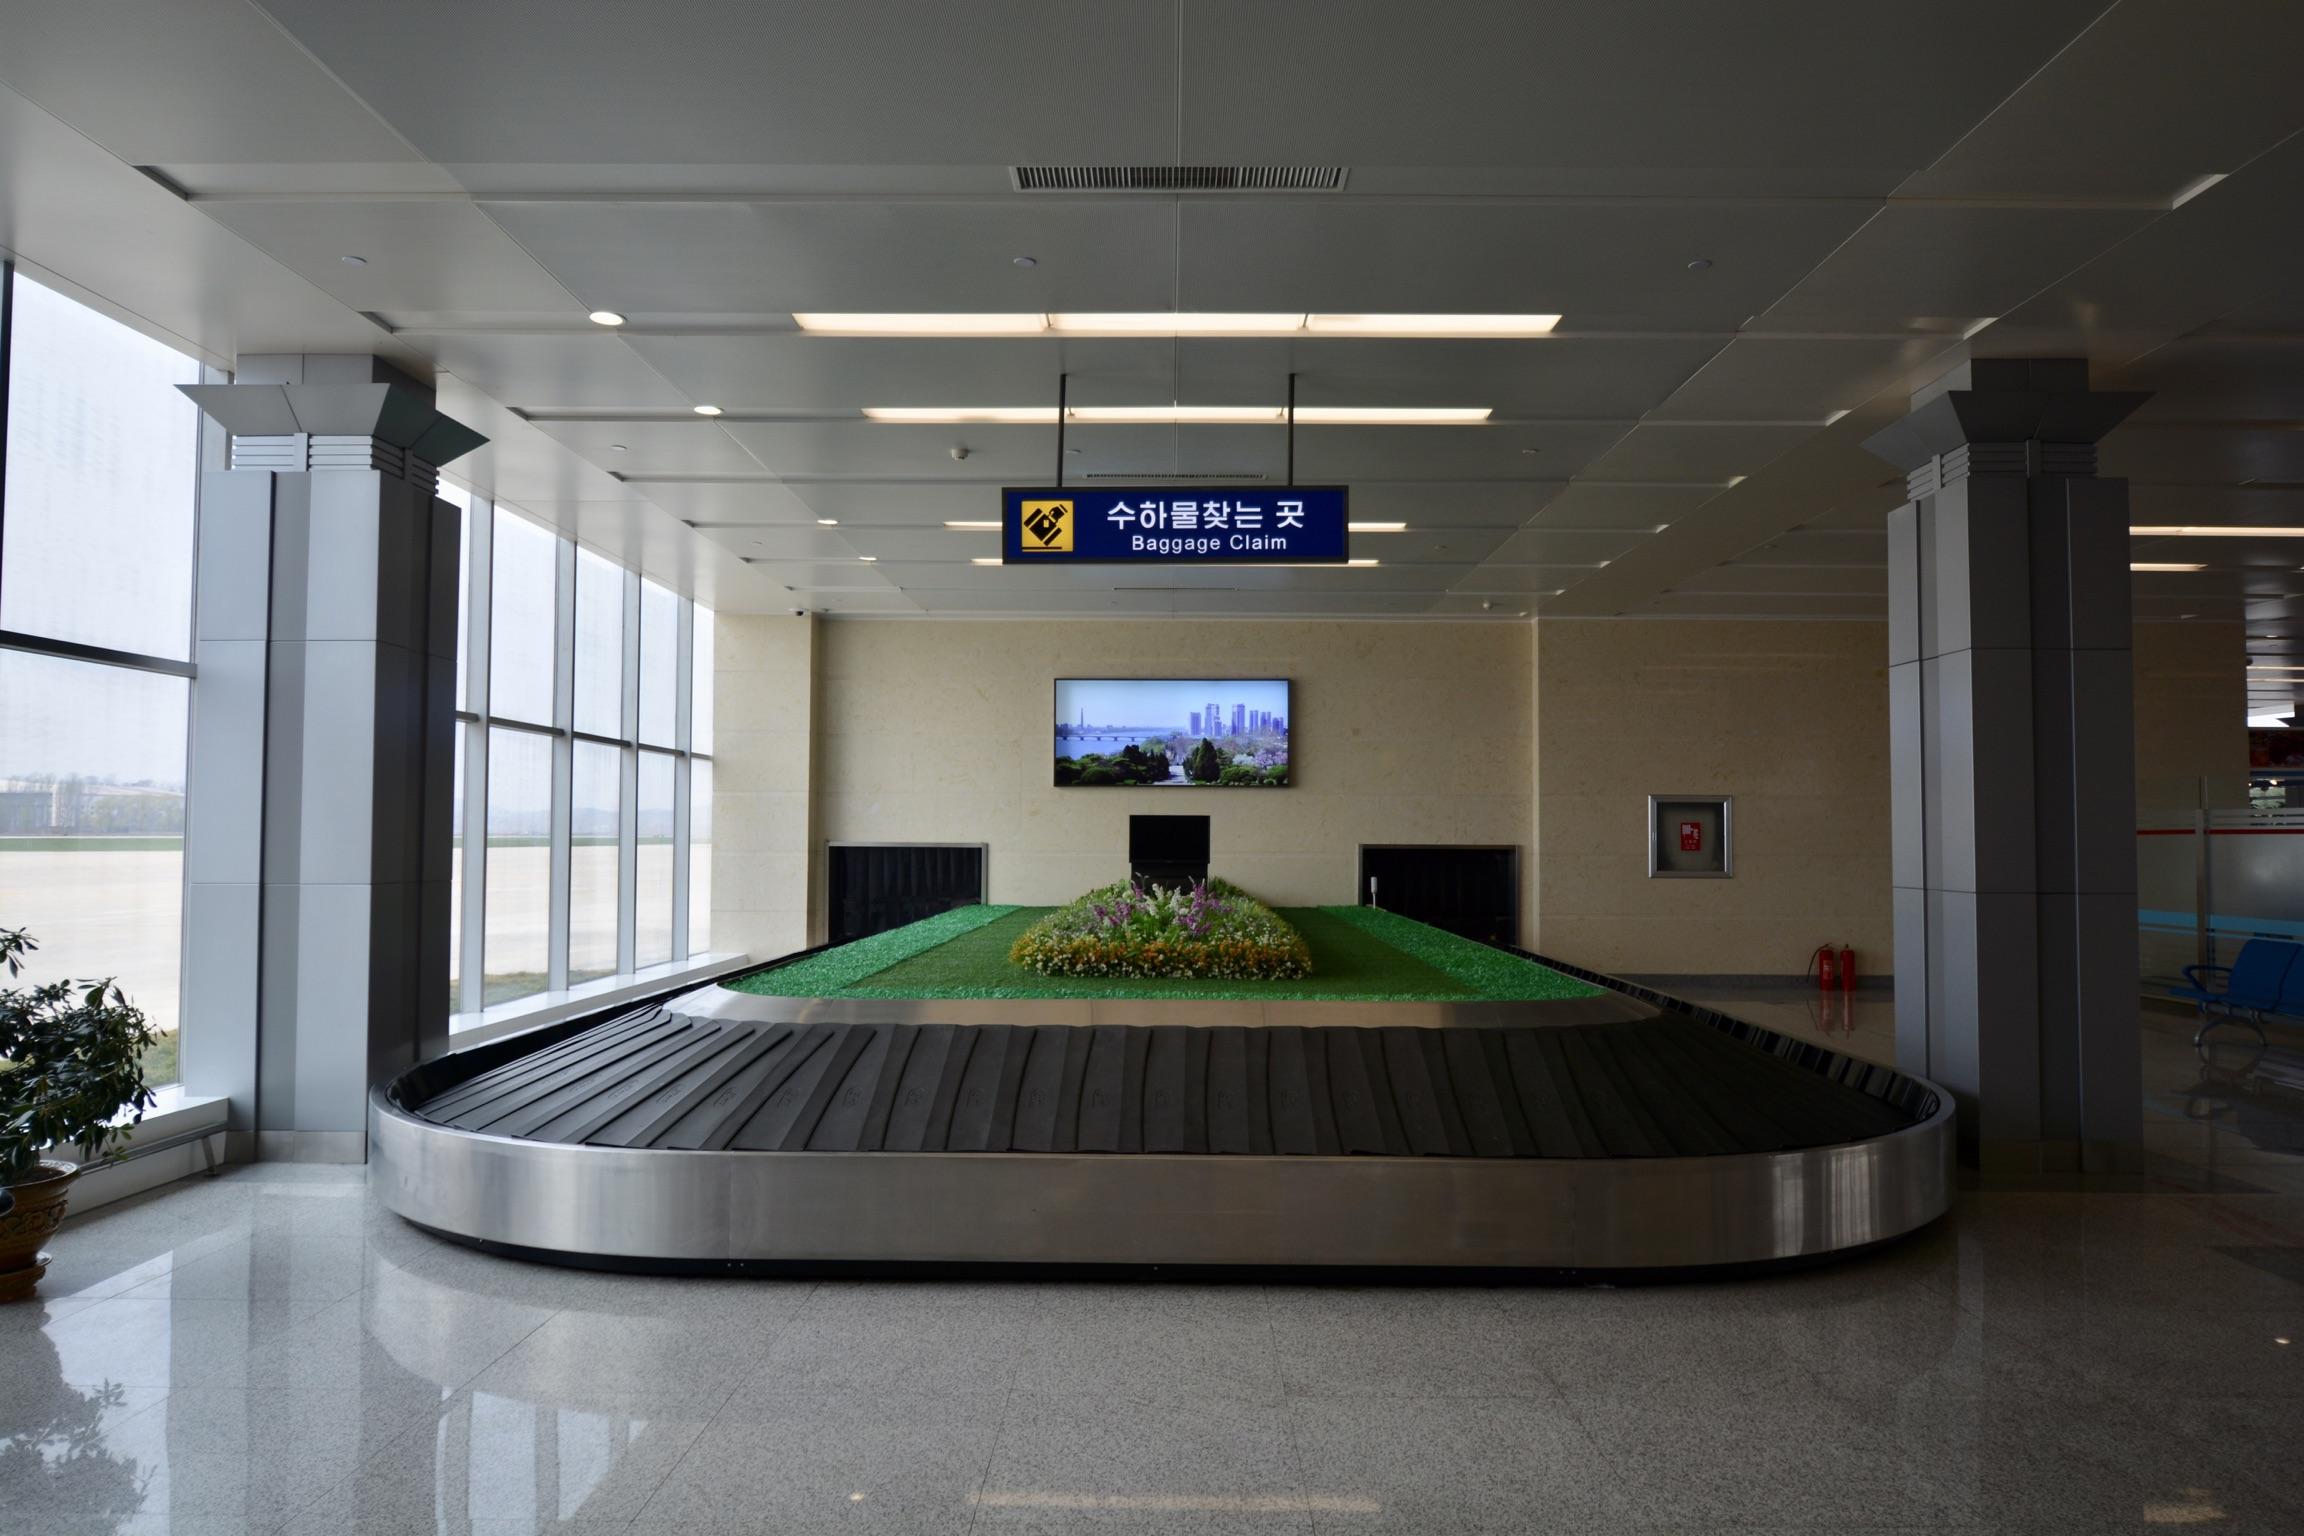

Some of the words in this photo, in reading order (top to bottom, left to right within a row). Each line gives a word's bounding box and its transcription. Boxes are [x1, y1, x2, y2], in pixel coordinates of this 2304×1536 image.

[1106, 500, 1263, 530] 수하물찾는
[1275, 500, 1305, 529] 곳
[1132, 535, 1221, 554] Baggage
[1229, 534, 1287, 551] Claim
